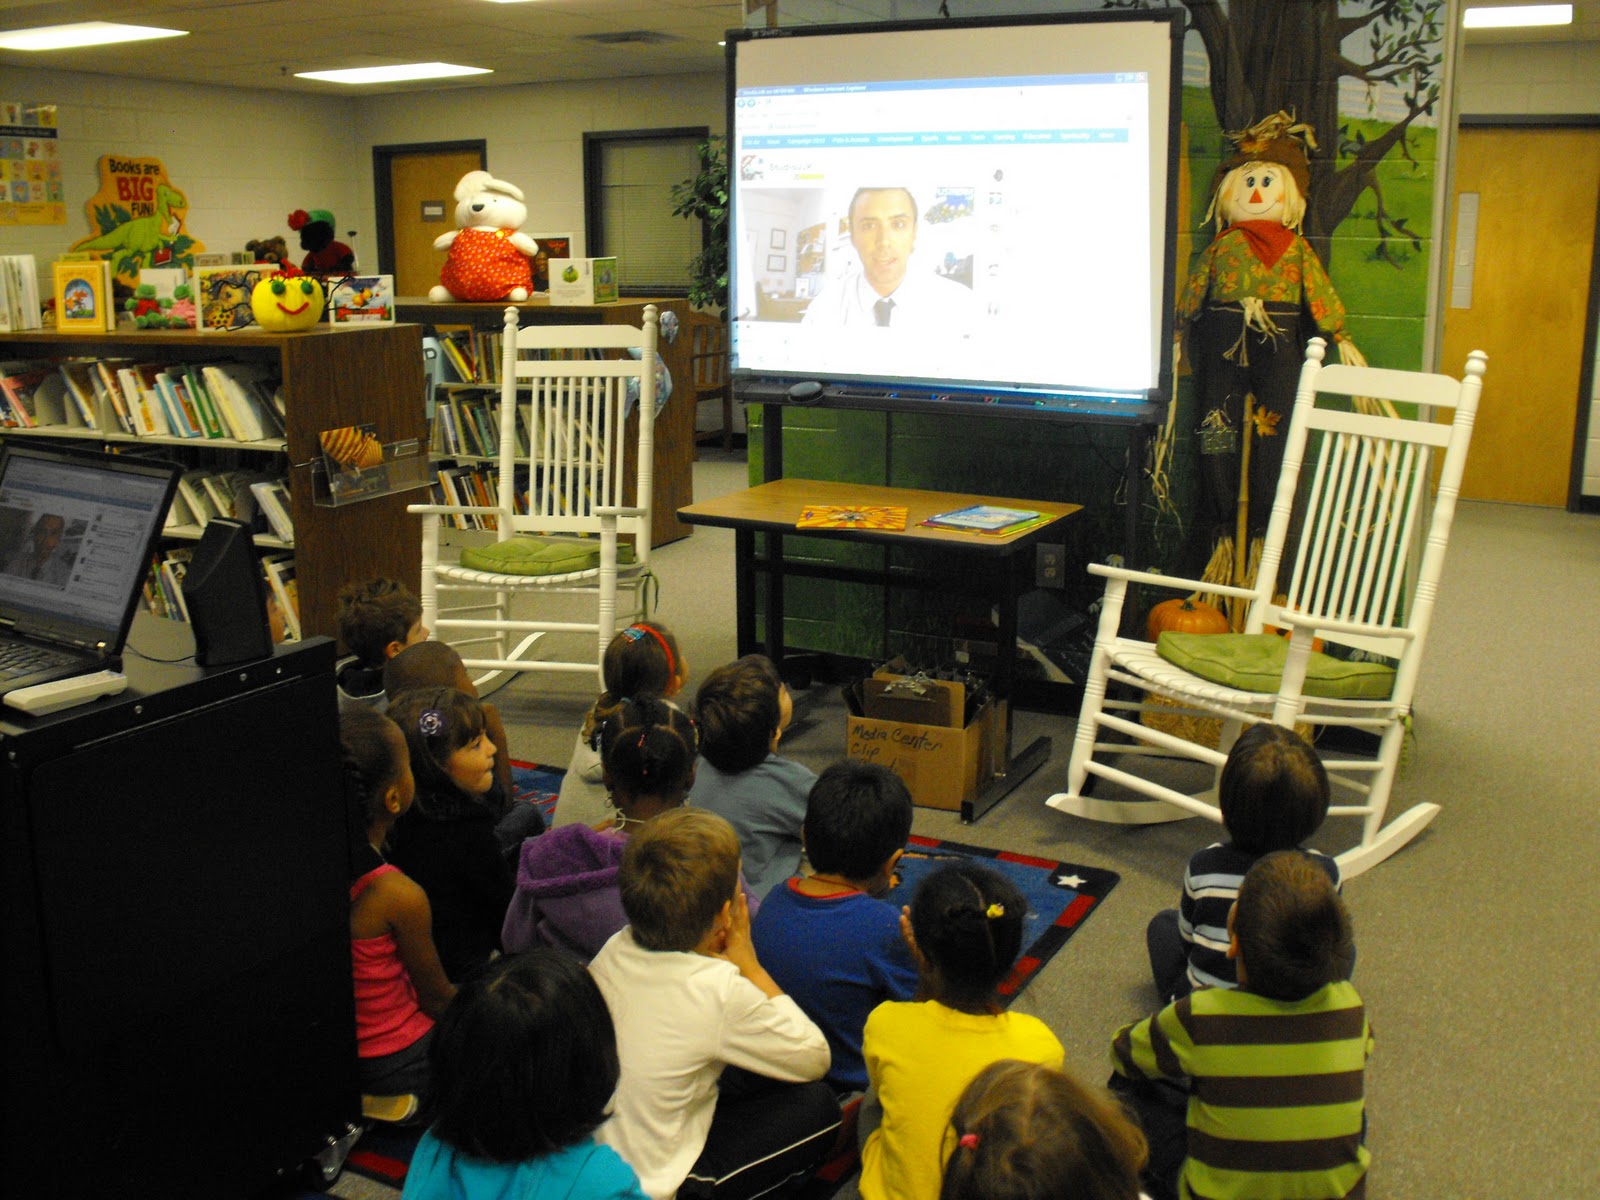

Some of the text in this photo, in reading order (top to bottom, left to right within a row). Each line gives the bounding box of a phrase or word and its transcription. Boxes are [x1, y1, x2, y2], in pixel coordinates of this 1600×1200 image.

[117, 176, 154, 201] BIG
[852, 724, 942, 751] Media Center
[851, 742, 880, 761] Clip
